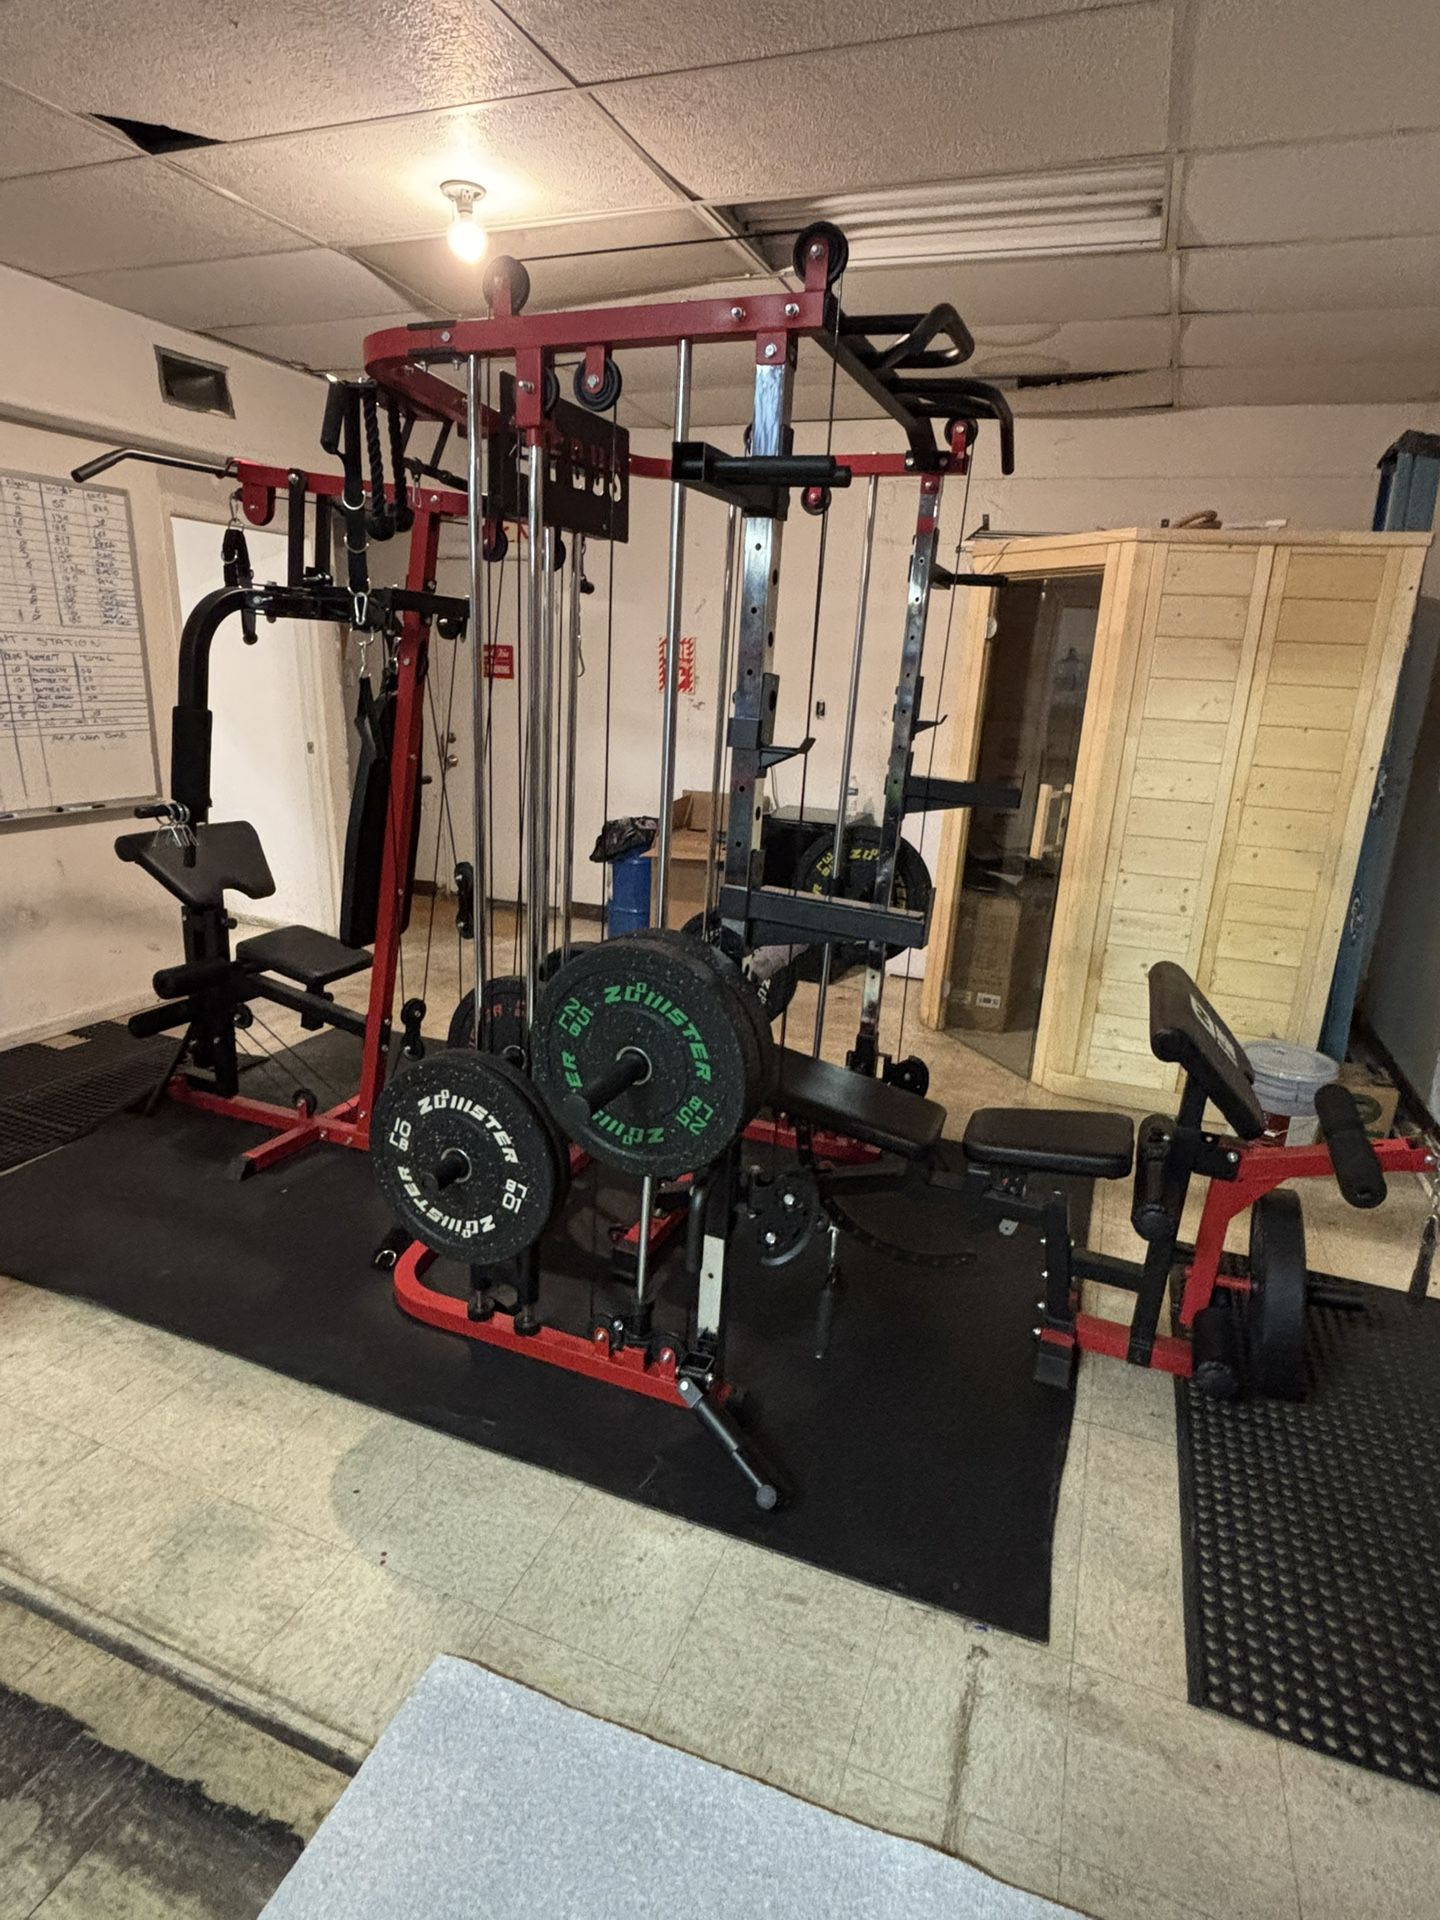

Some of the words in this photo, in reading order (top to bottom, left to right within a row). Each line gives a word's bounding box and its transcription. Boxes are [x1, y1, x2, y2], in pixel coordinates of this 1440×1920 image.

[563, 997, 594, 1027] 25
[558, 1014, 582, 1037] LB
[688, 1096, 714, 1122] LB
[394, 1117, 412, 1138] 10
[389, 1131, 409, 1151] LB
[505, 1179, 528, 1198] LB
